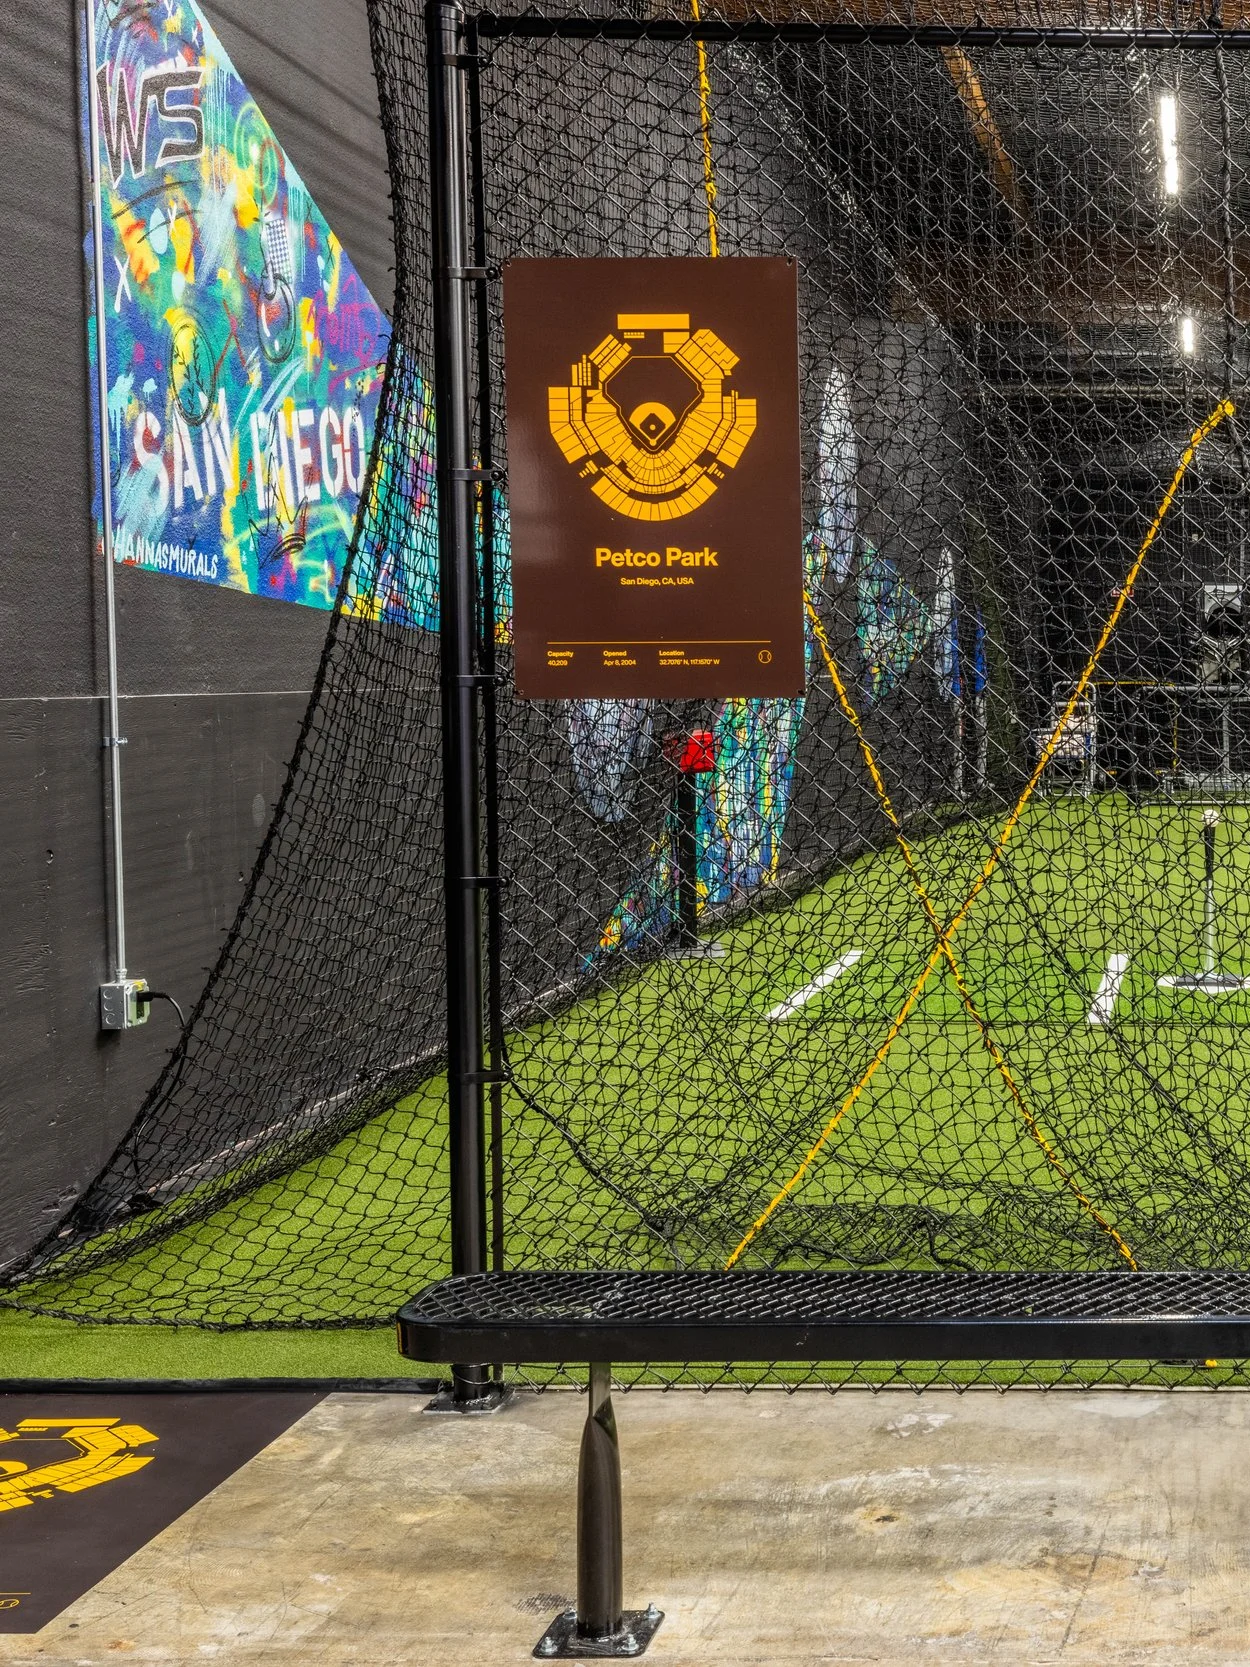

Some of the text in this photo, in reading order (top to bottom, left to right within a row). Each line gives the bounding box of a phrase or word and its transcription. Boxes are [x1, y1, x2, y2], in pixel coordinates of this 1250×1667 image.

[96, 60, 204, 189] WS
[134, 389, 367, 514] SAN DIEGO
[596, 547, 718, 567] Petco Park
[620, 577, 694, 587] San Diego, CA, USA
